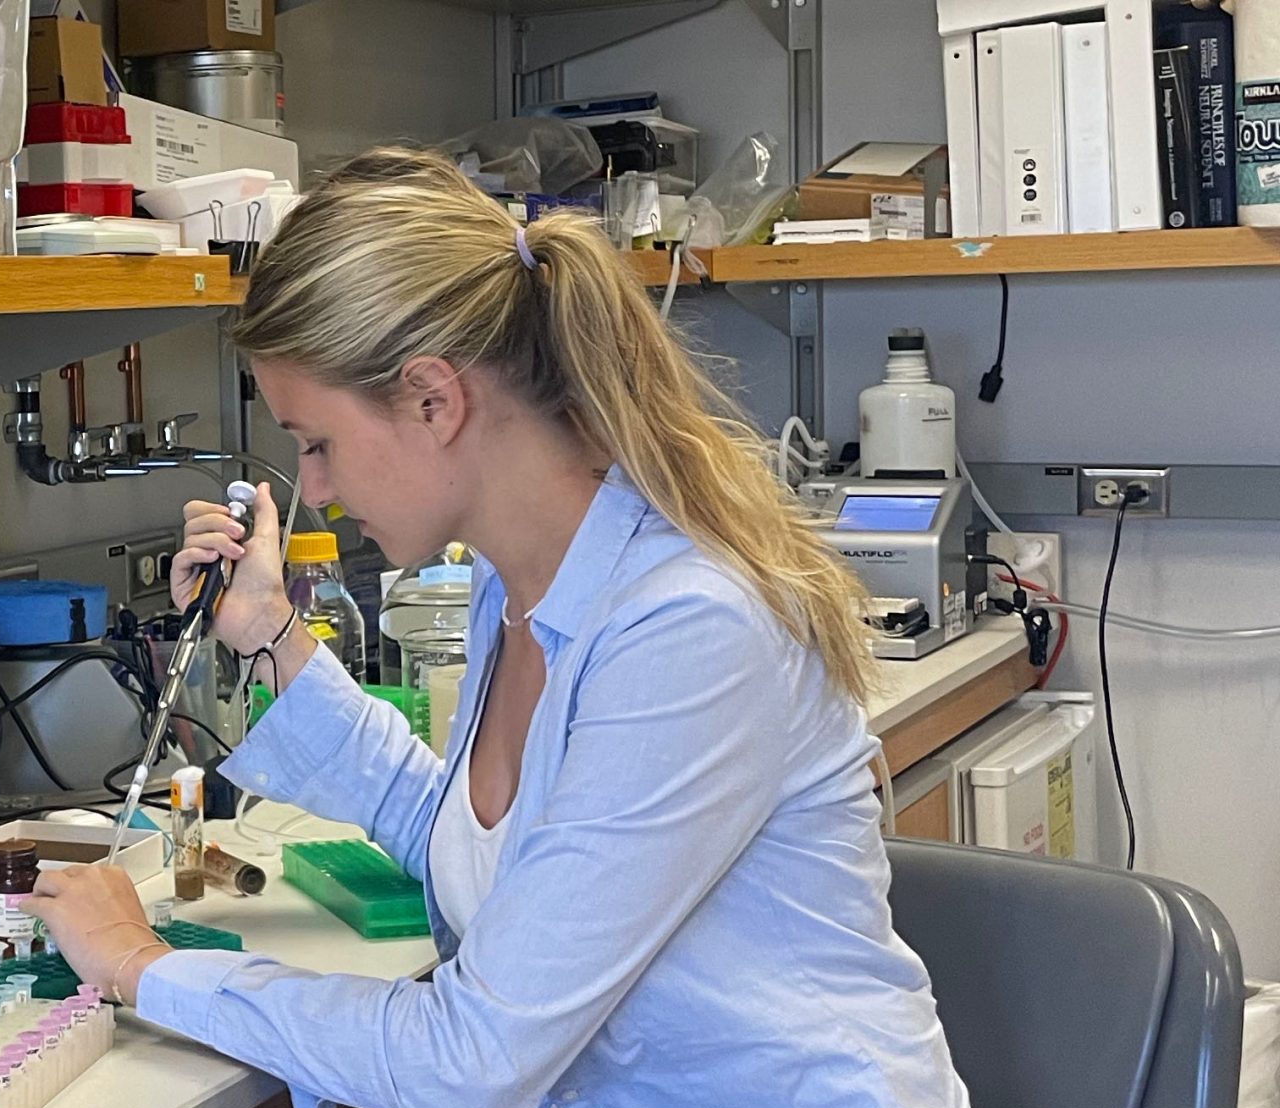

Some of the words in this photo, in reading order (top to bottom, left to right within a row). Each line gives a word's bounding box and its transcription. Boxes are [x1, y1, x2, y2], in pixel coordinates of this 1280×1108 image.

[1199, 85, 1213, 135] NEURAL
[1211, 83, 1226, 151] PRINCIPLES
[1200, 139, 1214, 189] SCIENCE
[1213, 151, 1226, 167] OF
[927, 407, 949, 417] FULL
